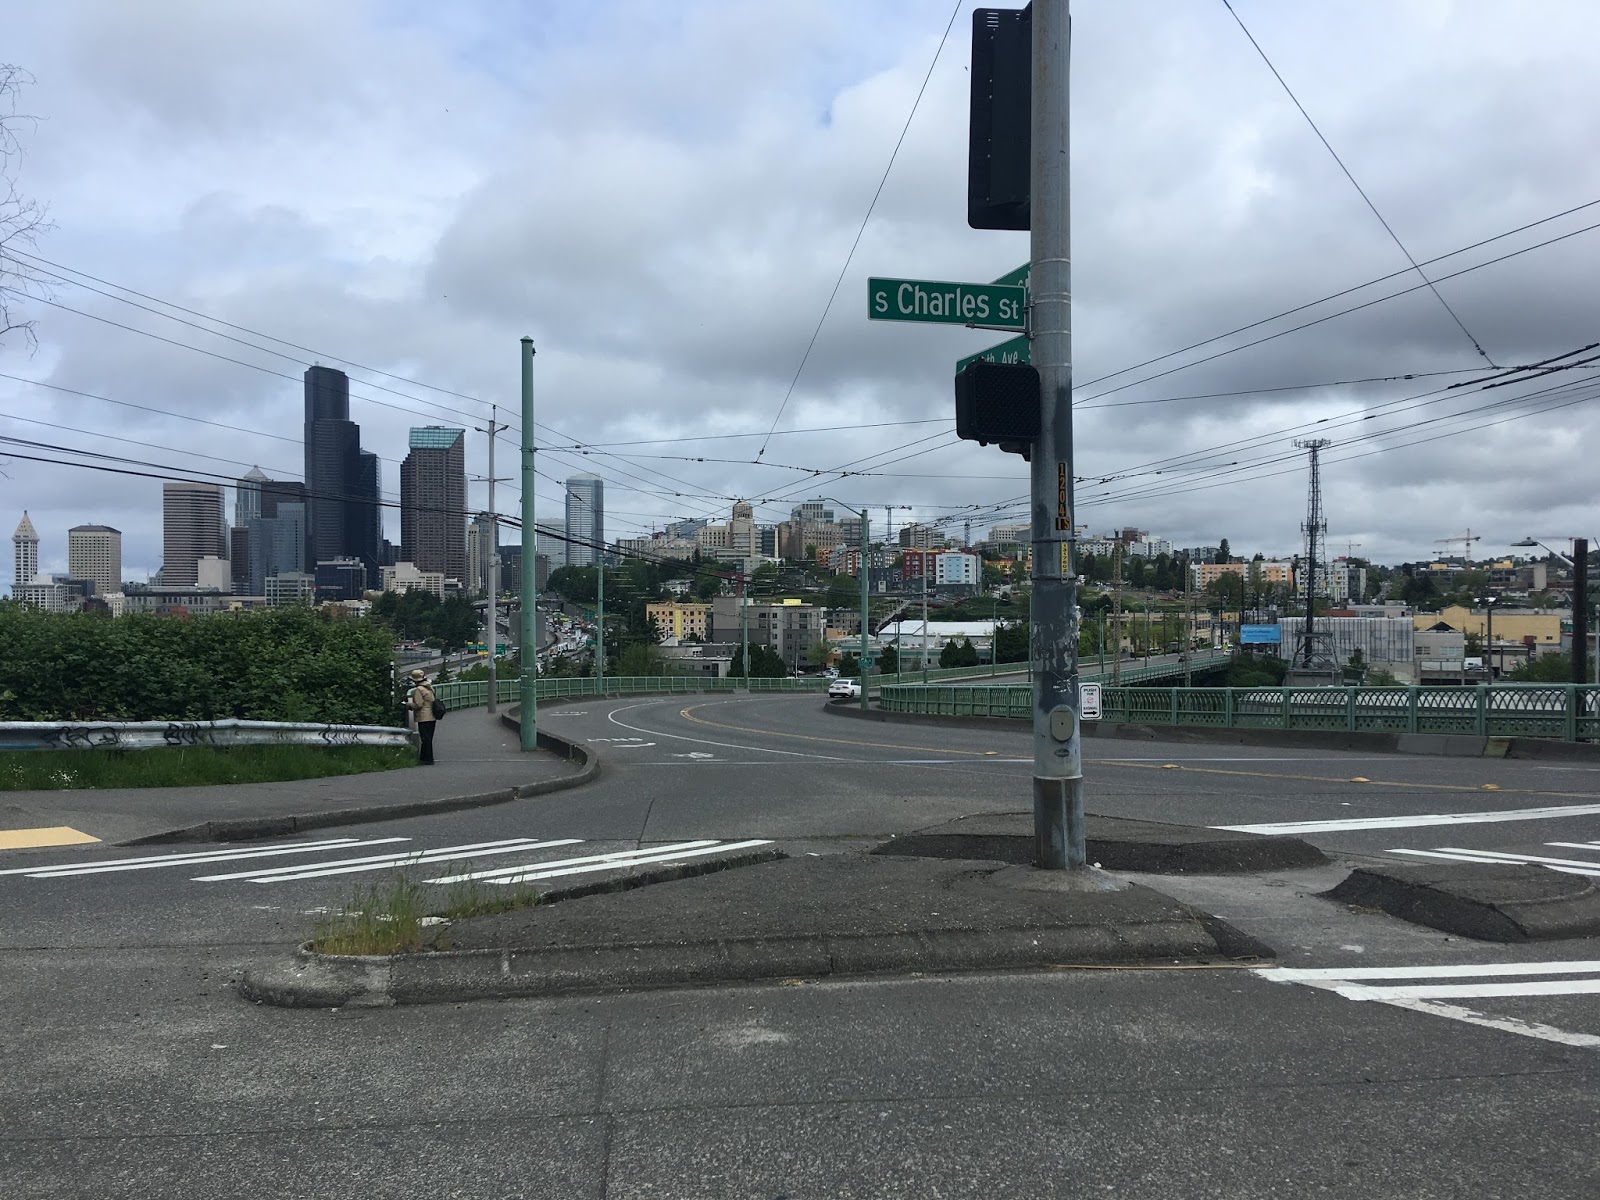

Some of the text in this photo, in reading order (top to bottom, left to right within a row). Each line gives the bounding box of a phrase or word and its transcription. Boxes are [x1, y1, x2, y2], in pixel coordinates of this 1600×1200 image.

[875, 283, 1019, 320] S Charles St
[1002, 351, 1019, 364] Ave
